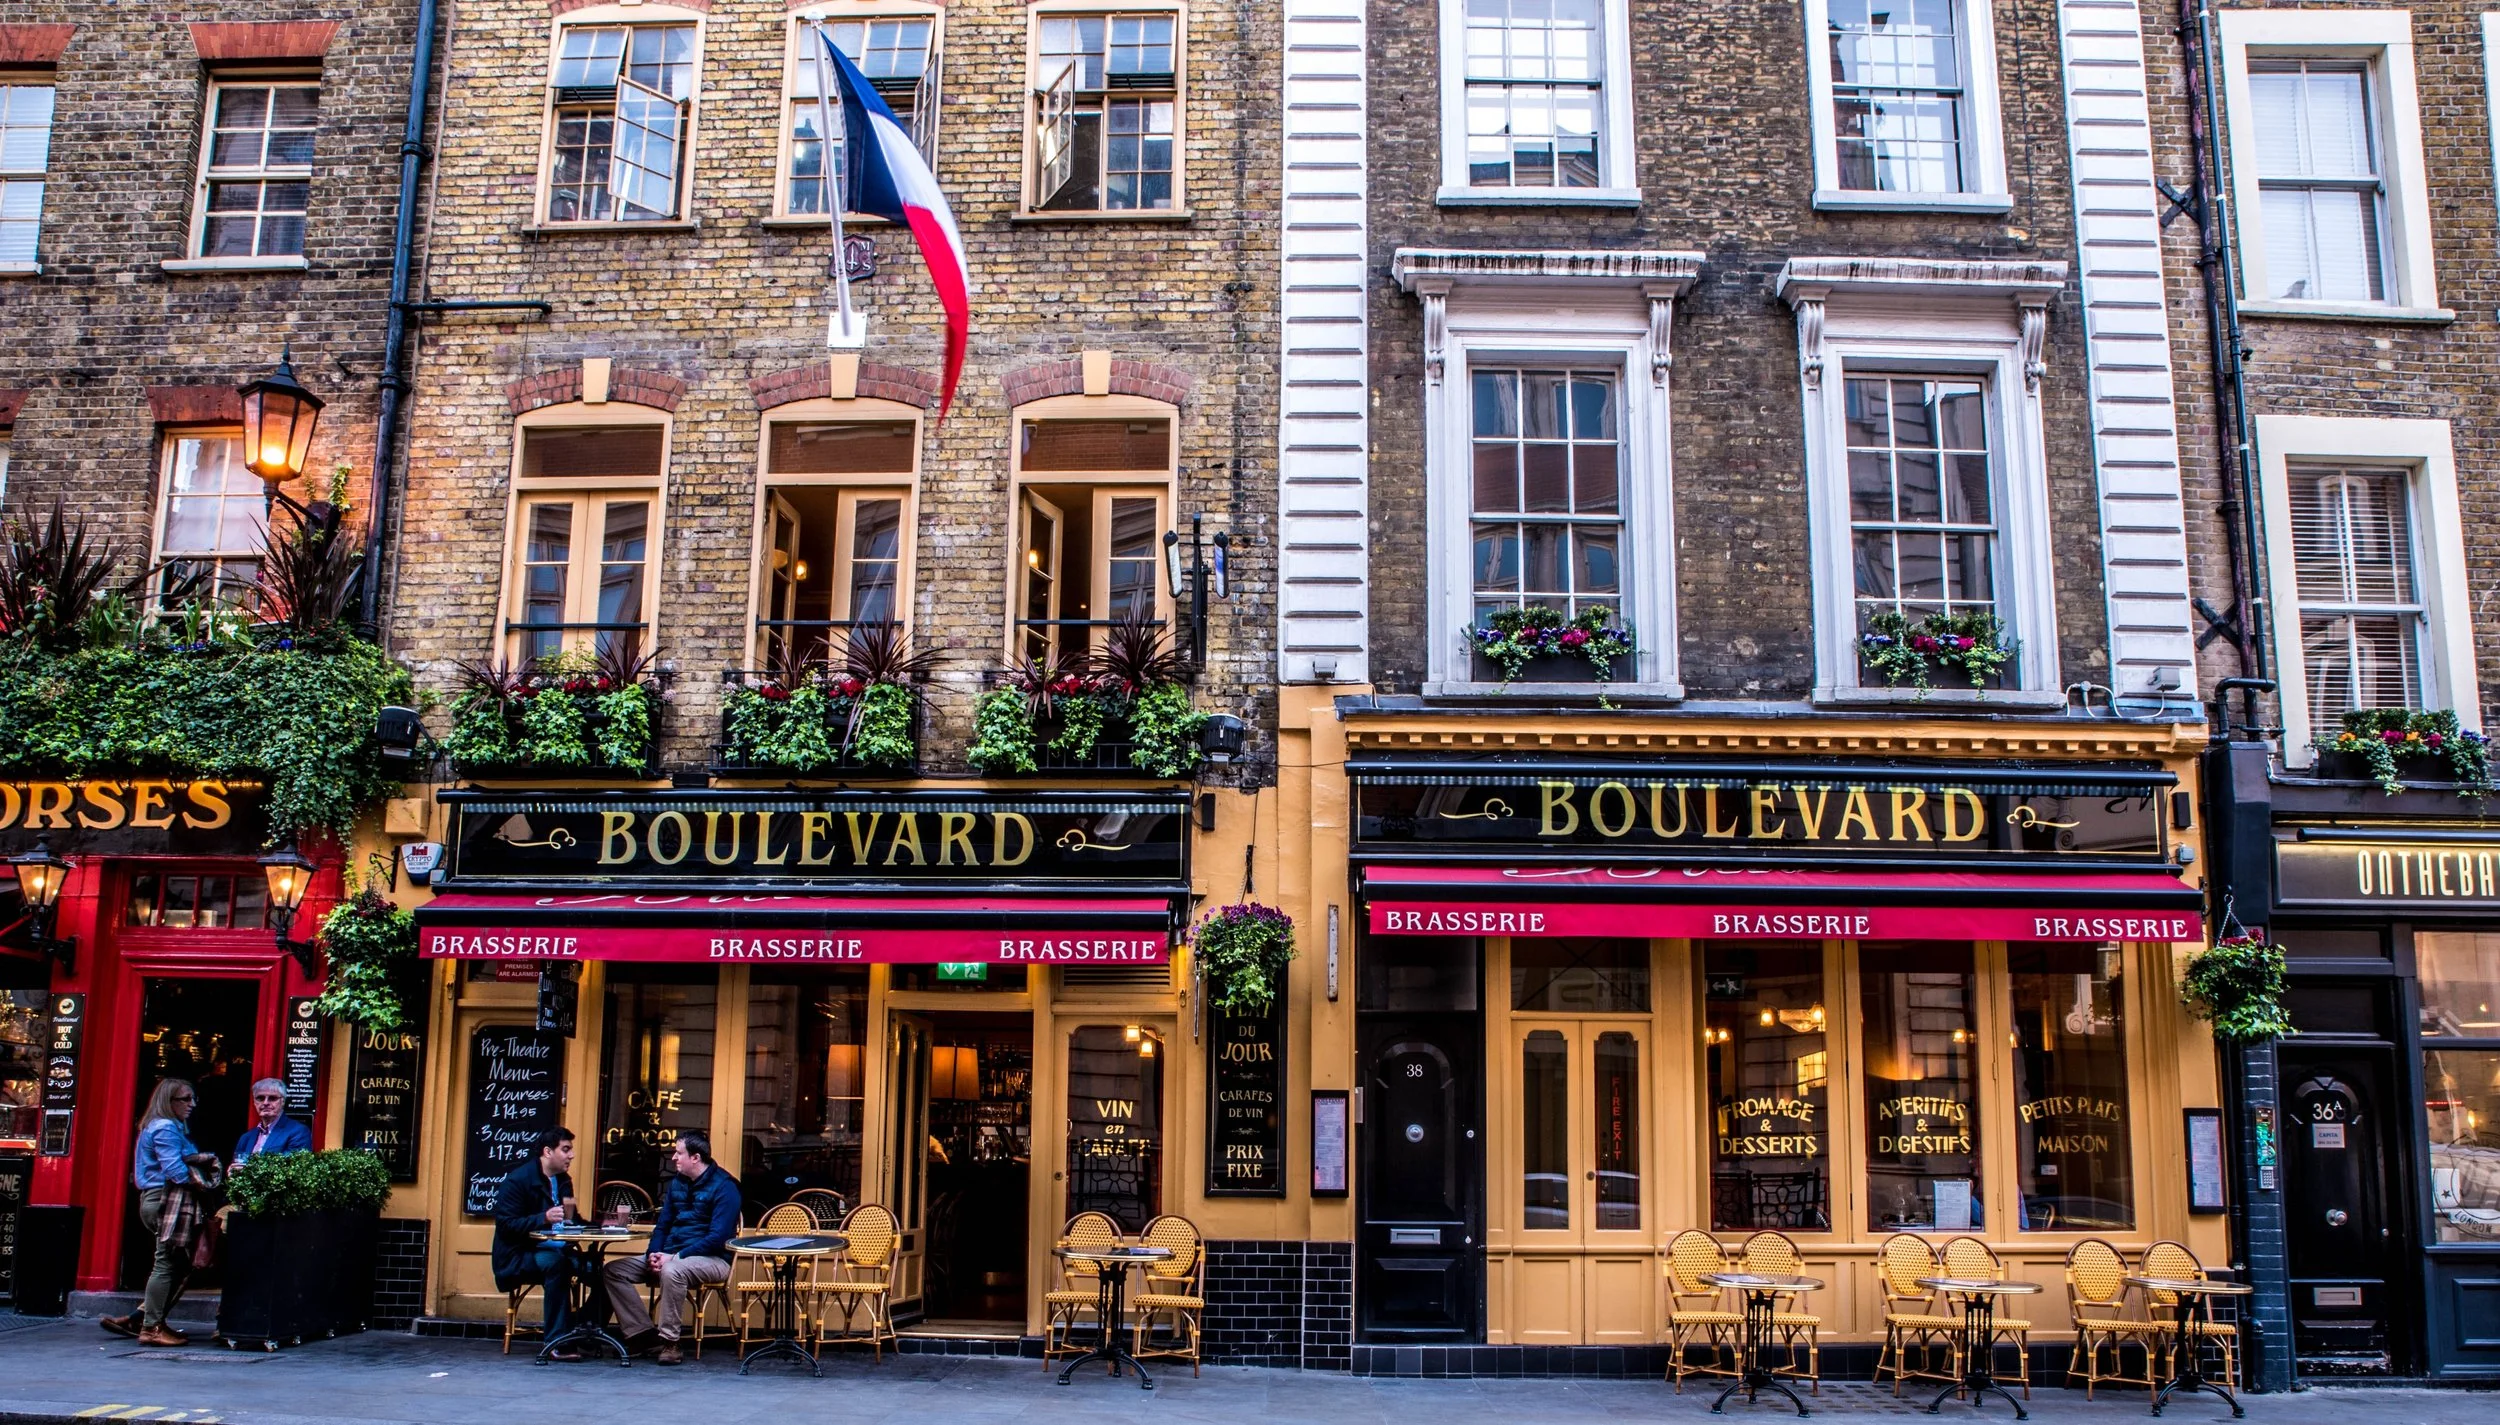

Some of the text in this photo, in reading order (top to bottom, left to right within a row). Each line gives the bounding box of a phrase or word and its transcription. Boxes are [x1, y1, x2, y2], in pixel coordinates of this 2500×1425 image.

[1538, 781, 1986, 842] BOULEVARD
[597, 810, 1036, 867] BOULEVARD
[1386, 910, 1545, 934] BRASSERIE
[1714, 914, 1870, 935] BRASSERIE
[2033, 916, 2189, 940] BRASSERIE
[430, 935, 578, 956] BRASSERIE
[710, 938, 862, 959] BRASSERIE
[1000, 938, 1156, 960] BRASSERIE
[57, 1026, 73, 1034] HOT
[1239, 1025, 1256, 1037] DU
[481, 1037, 550, 1058] Pre-Theatre
[1220, 1042, 1273, 1062] JOUR
[1406, 1064, 1423, 1078] 38
[361, 1078, 410, 1090] CARAFES
[368, 1095, 400, 1104] DE VIN
[628, 1089, 684, 1111] CAFÉ
[1220, 1090, 1273, 1103] CARAFES
[492, 1103, 537, 1119] £14.95
[1096, 1100, 1133, 1118] VIN
[1228, 1108, 1263, 1118] DE VIN
[1720, 1097, 1815, 1122] FROMAGE
[1880, 1096, 1966, 1121] APERITIFS
[2020, 1096, 2120, 1124] PETITS PLATS
[1105, 1124, 1124, 1134] en
[1760, 1119, 1772, 1132] &
[1916, 1118, 1928, 1132] &
[364, 1130, 399, 1144] PRIX
[1720, 1136, 1817, 1154] DESSERTS
[1879, 1135, 1971, 1154] DIGESTIFS
[2038, 1134, 2108, 1153] MAISON
[488, 1144, 530, 1160] £17.95
[1226, 1144, 1264, 1159] PRIX
[470, 1172, 508, 1184] Served
[1227, 1164, 1262, 1178] FIXE
[2454, 1210, 2492, 1234] LONDON
